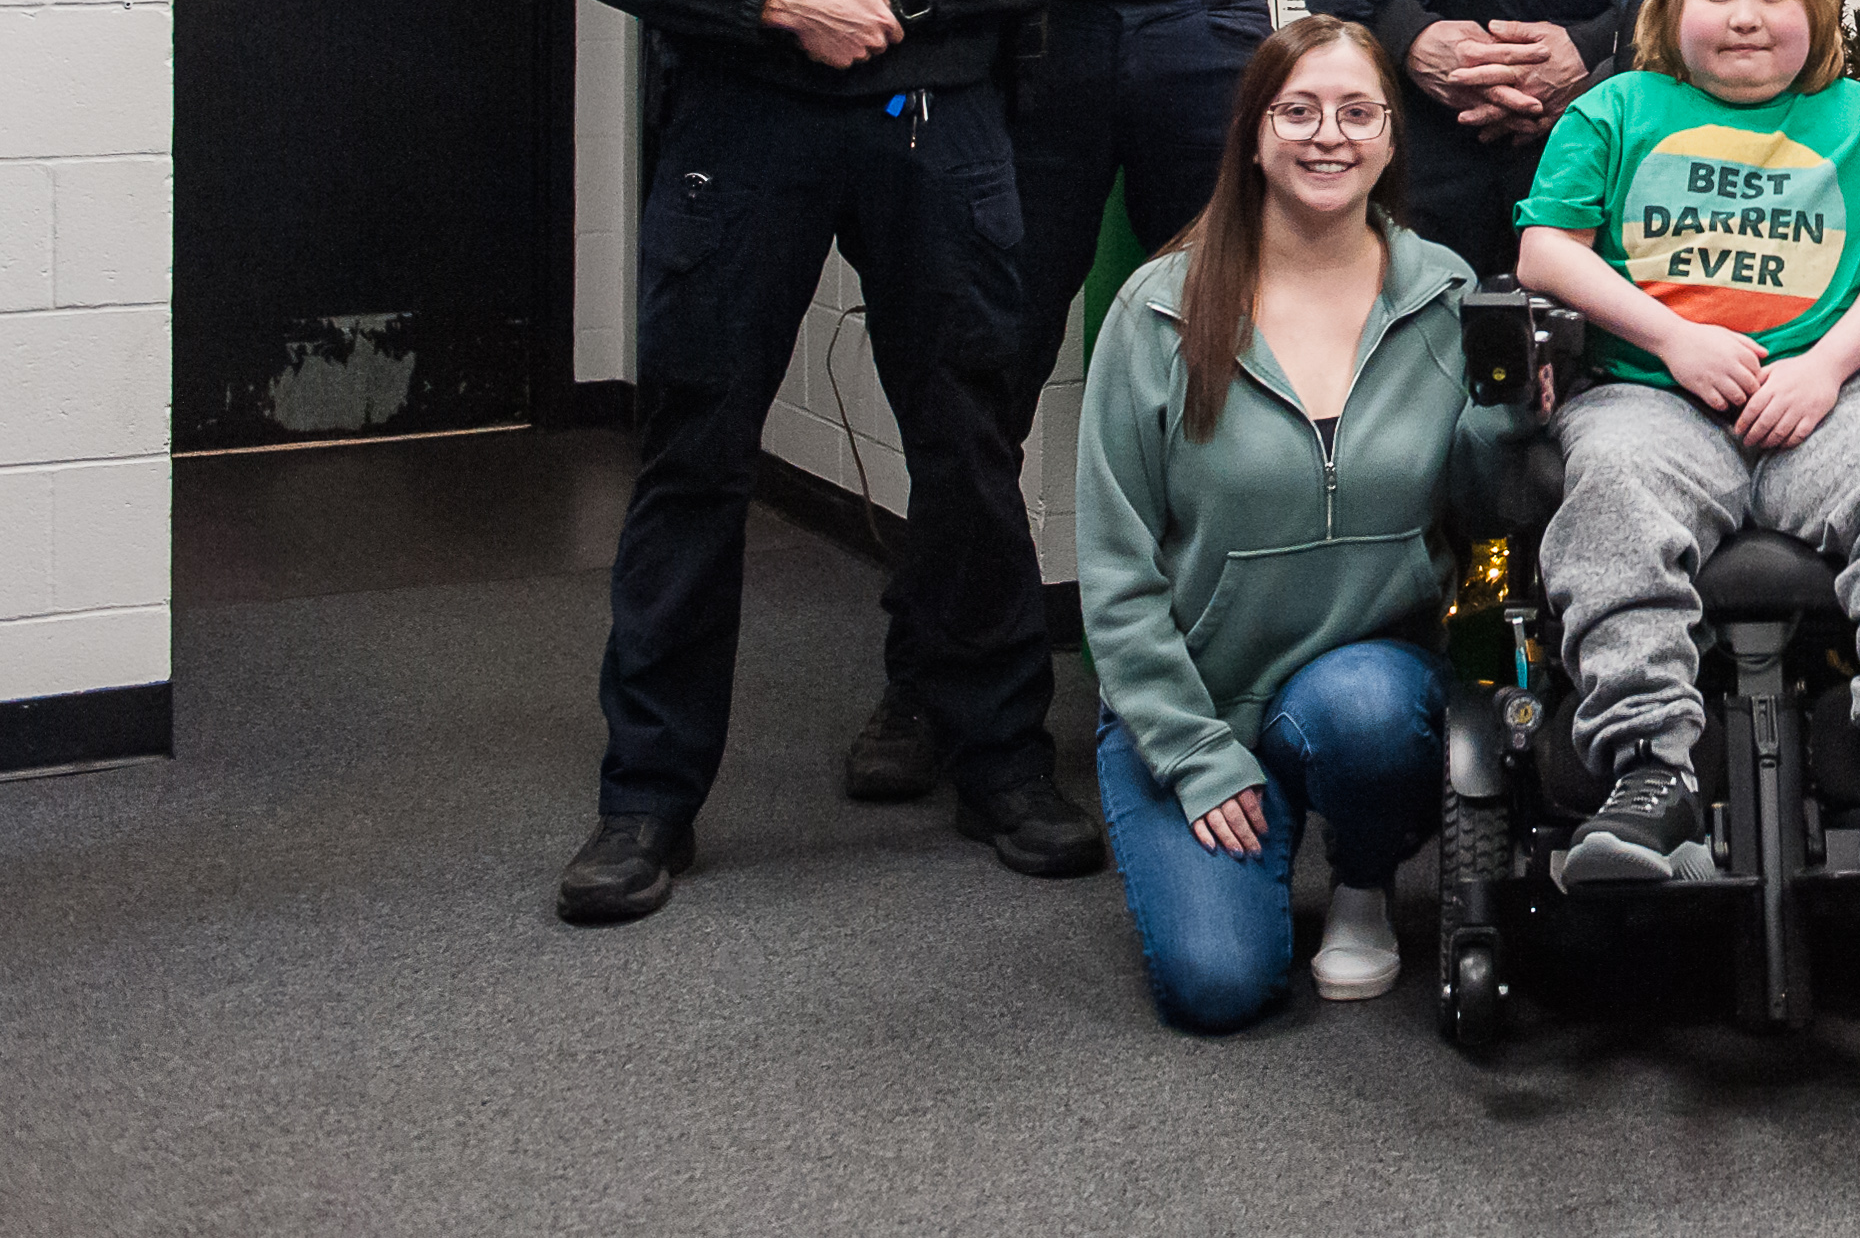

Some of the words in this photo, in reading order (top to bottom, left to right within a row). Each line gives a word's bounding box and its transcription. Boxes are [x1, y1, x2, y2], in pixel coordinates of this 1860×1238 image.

[1687, 162, 1791, 200] BEST
[1643, 205, 1825, 245] DARREN
[1667, 247, 1786, 287] EVER
